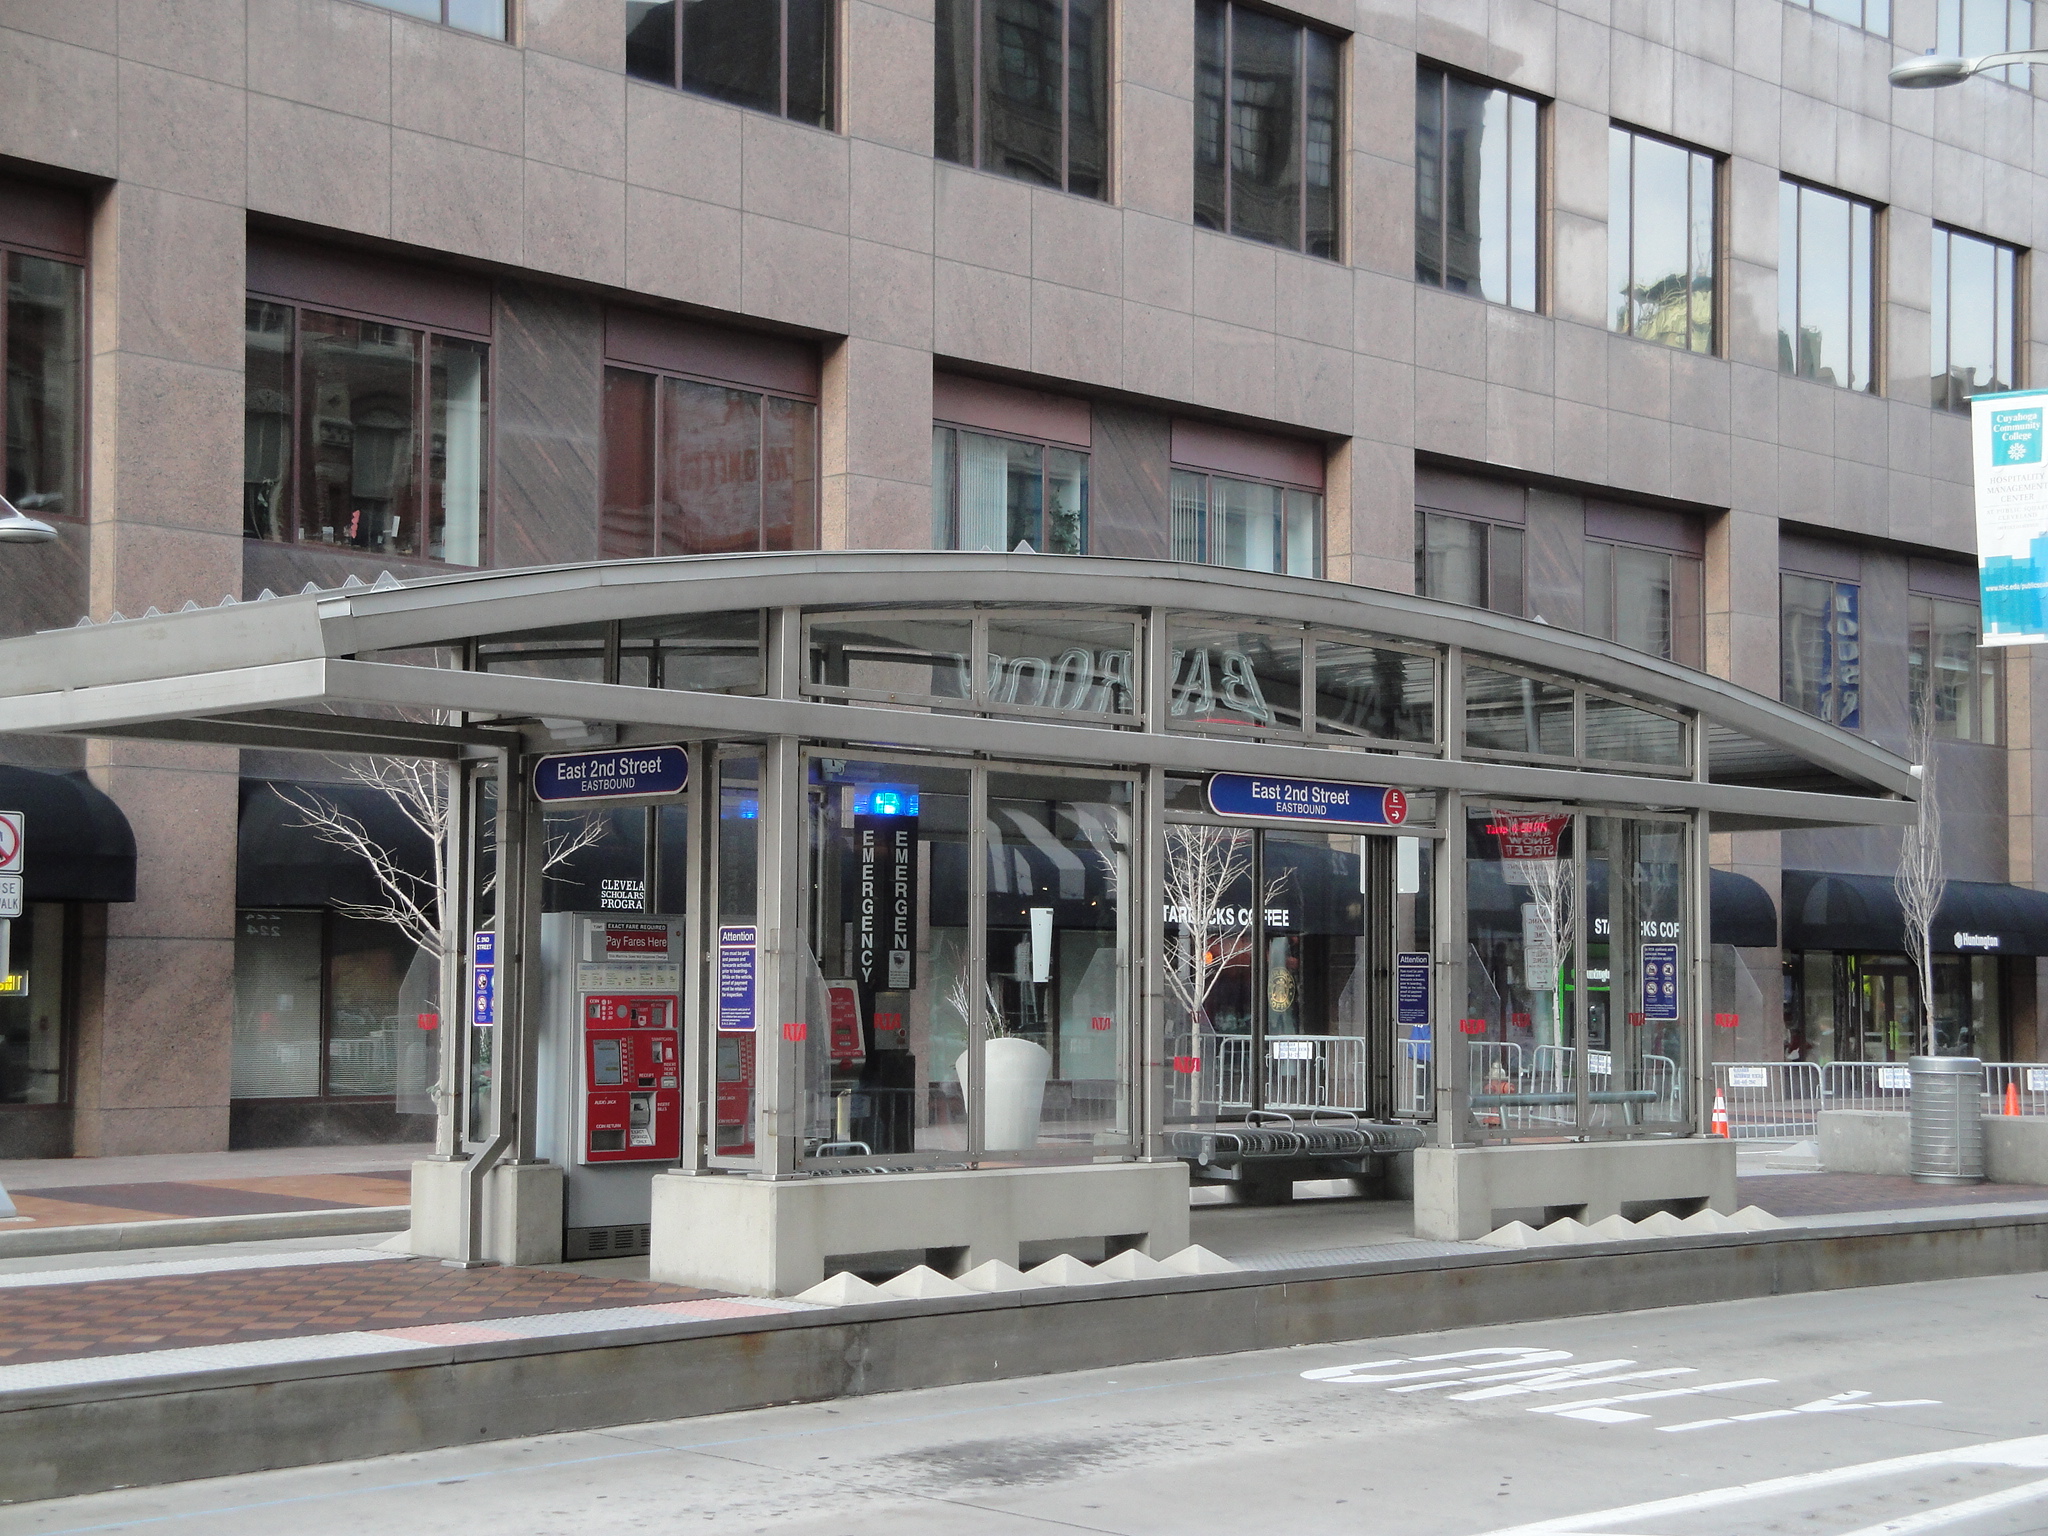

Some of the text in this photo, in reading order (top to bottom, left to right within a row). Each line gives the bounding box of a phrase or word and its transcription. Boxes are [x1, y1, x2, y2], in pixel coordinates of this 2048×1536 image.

[1996, 413, 2037, 424] Cuyahoga
[1993, 422, 2040, 432] Community
[2002, 432, 2032, 441] College
[1990, 473, 2044, 484] HOSPITALITY
[1987, 483, 2048, 494] MANAGEMENT
[2000, 494, 2034, 502] CENTER
[557, 756, 662, 780] East 2nd Street
[581, 778, 636, 792] EASTBOUND
[1252, 782, 1398, 805] East 2nd Street E
[1276, 802, 1327, 815] EASTBOUND
[602, 879, 644, 890] CLEVELA
[601, 891, 644, 899] SCHOLARS
[894, 831, 908, 950] EMERGEN
[0, 898, 18, 909] ALK
[601, 899, 643, 909] PROGRA
[861, 830, 874, 983] EMERGENCY
[606, 936, 667, 948] Pay Fares Here
[722, 932, 754, 941] Attention
[1963, 933, 1998, 950] Huntington
[1300, 1346, 1942, 1432] ONLY
